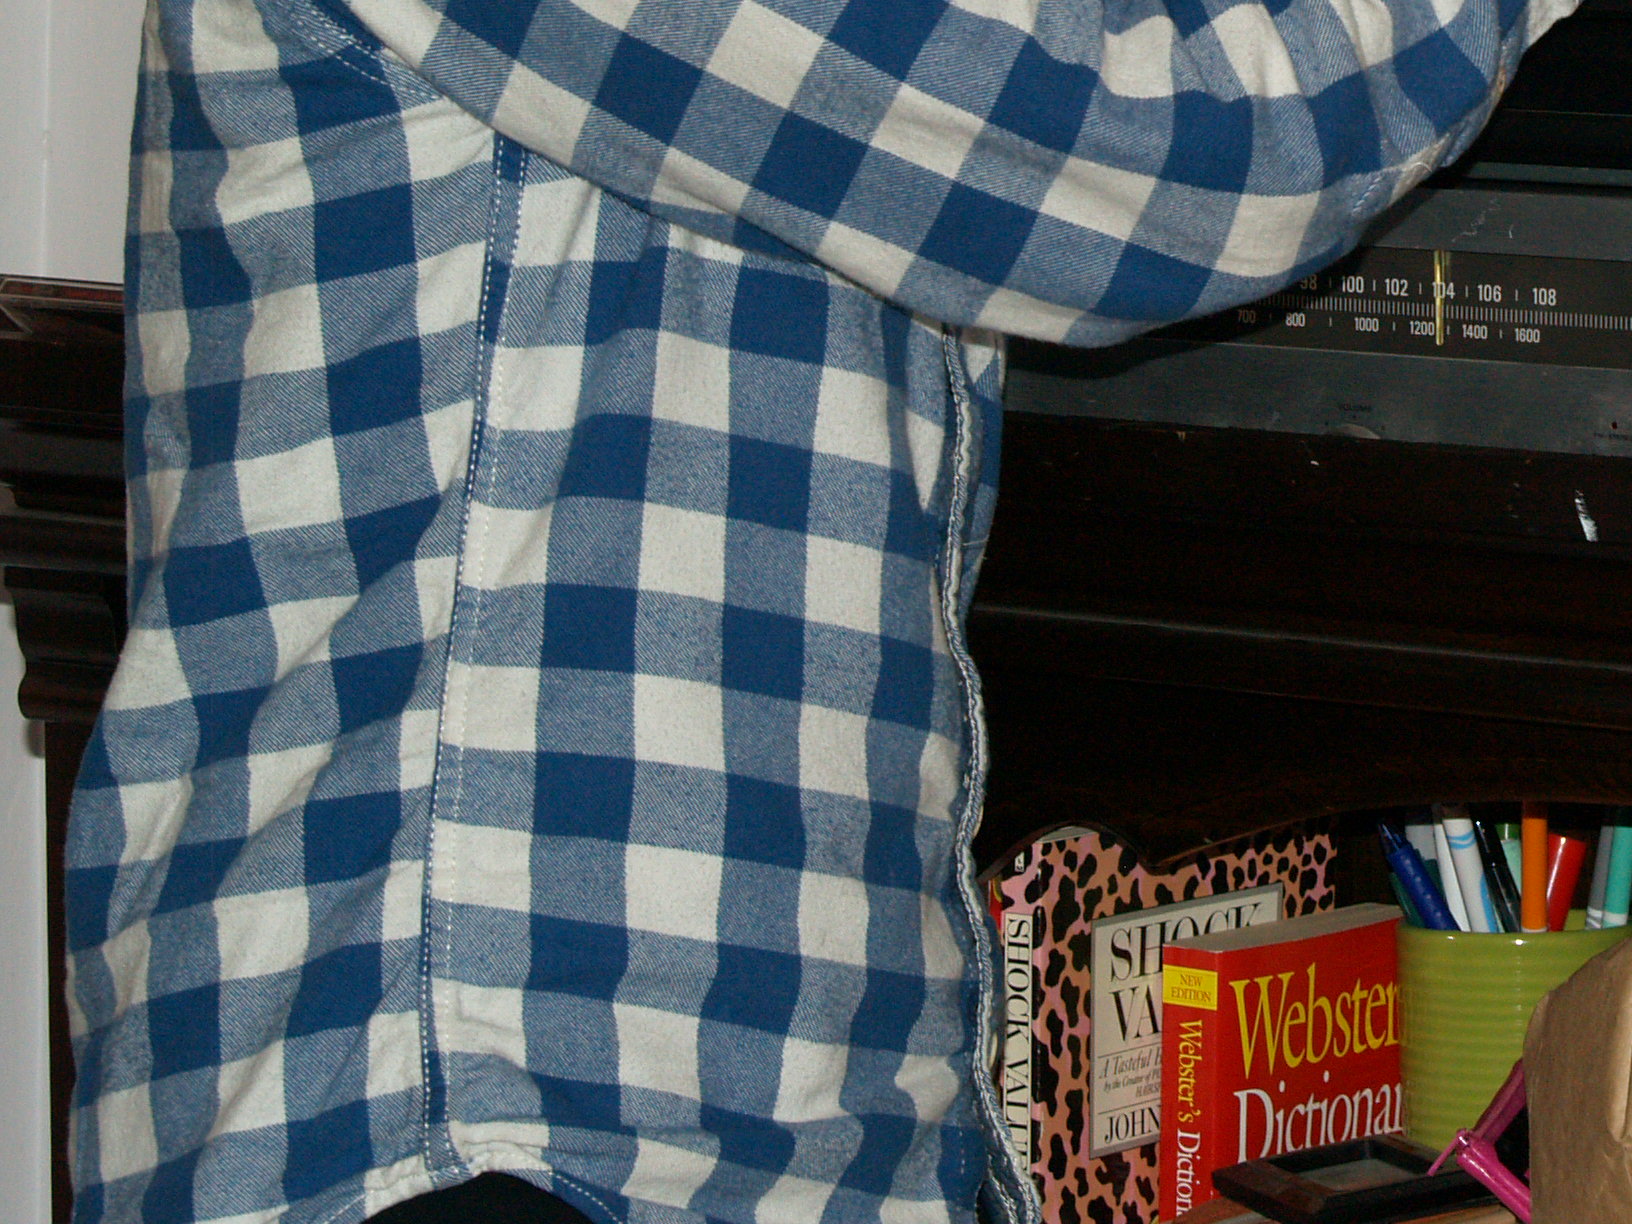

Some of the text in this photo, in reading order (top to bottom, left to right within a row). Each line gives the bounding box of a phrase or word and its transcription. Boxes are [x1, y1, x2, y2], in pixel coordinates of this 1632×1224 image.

[1299, 274, 1317, 292] 98
[1342, 276, 1364, 294] 100
[1385, 279, 1409, 297] 102
[1433, 281, 1456, 300] 104
[1477, 284, 1502, 303] 106
[1532, 287, 1557, 306] 108
[1238, 308, 1256, 324] 700
[1286, 312, 1305, 328] 800
[1354, 316, 1379, 332] 1000
[1410, 320, 1435, 337] 1200
[1462, 324, 1488, 341] 1400
[1515, 327, 1541, 344] 1600
[1006, 919, 1031, 1055] SHOCK
[1171, 986, 1212, 1003] EDITION
[1180, 974, 1203, 987] NEW
[1113, 1048, 1153, 1075] Tasteful
[1178, 1019, 1202, 1123] Webster's
[1105, 1105, 1161, 1144] JOHN
